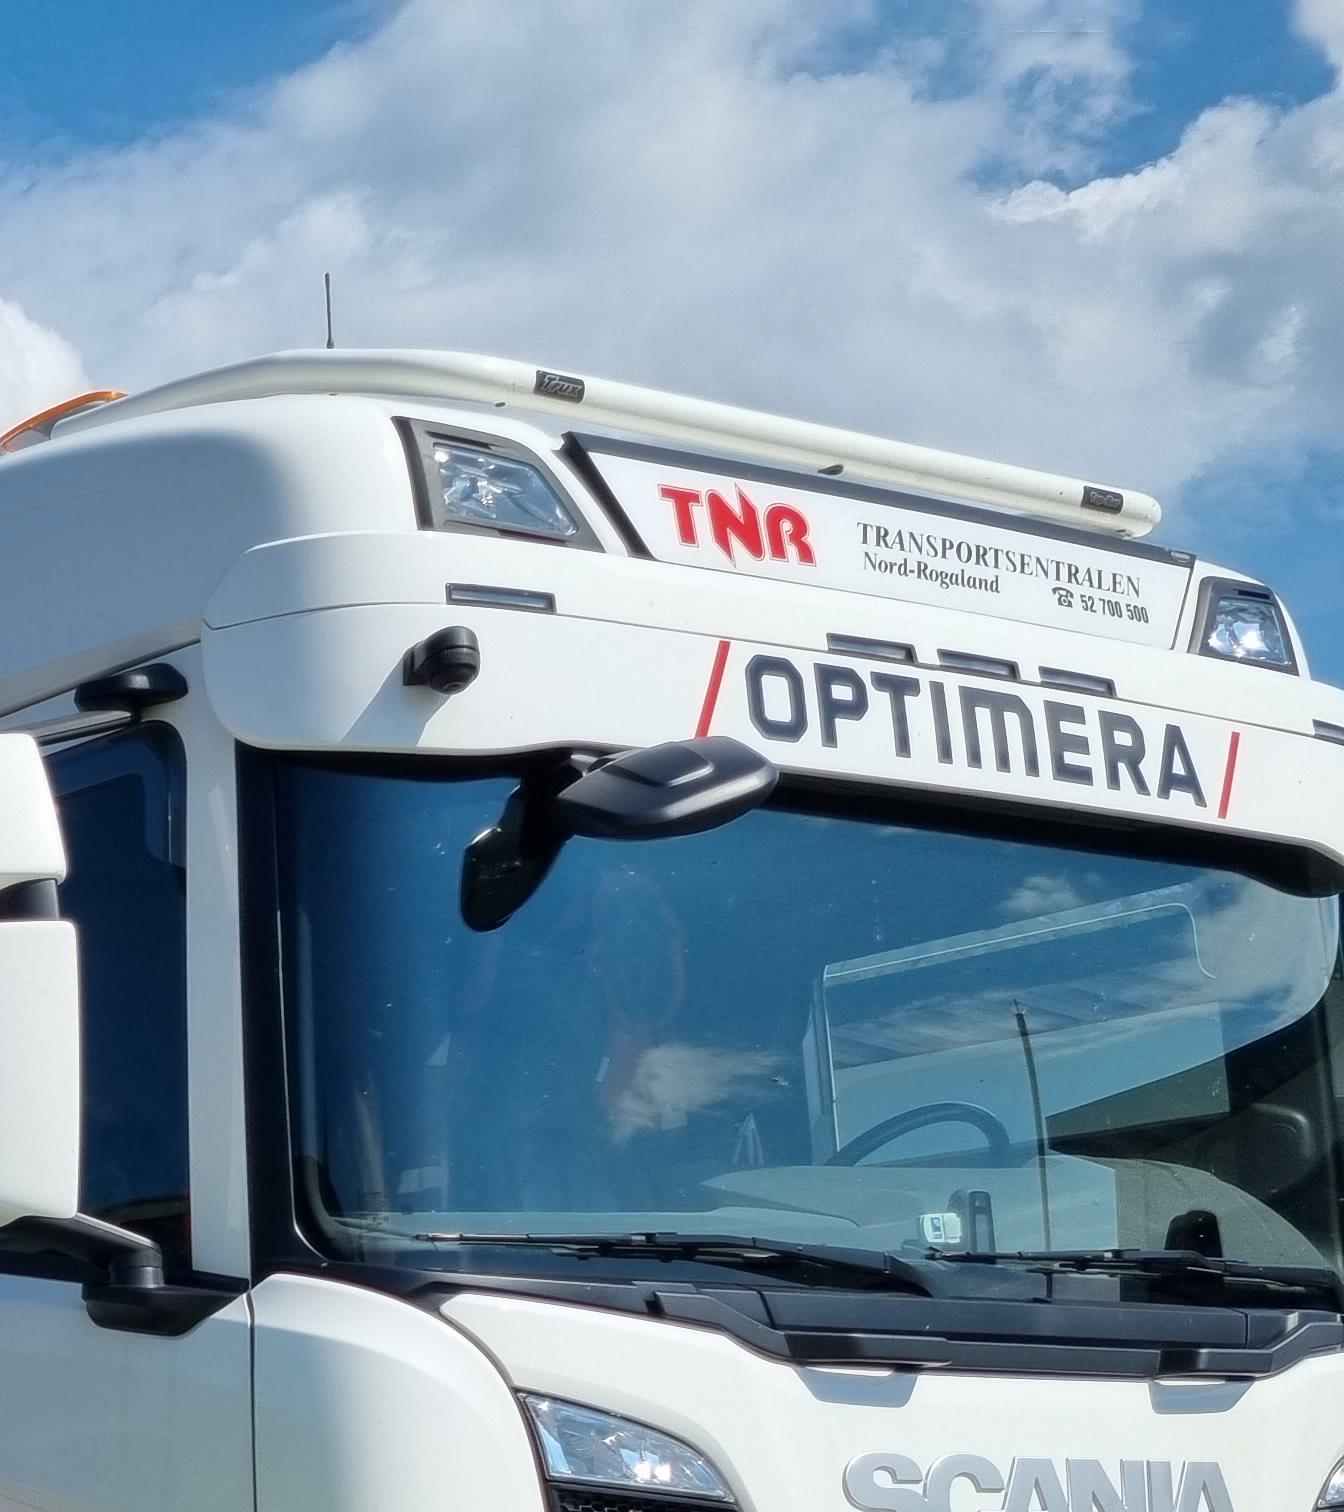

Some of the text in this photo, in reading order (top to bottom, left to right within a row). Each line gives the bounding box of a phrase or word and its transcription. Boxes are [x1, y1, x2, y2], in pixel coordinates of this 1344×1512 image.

[540, 374, 583, 398] Trux
[657, 482, 818, 569] TNR
[856, 521, 1141, 599] TRANSPORTSENTRALEN
[863, 551, 1001, 594] Nord-Rogaland
[1080, 594, 1150, 624] 52 700 500
